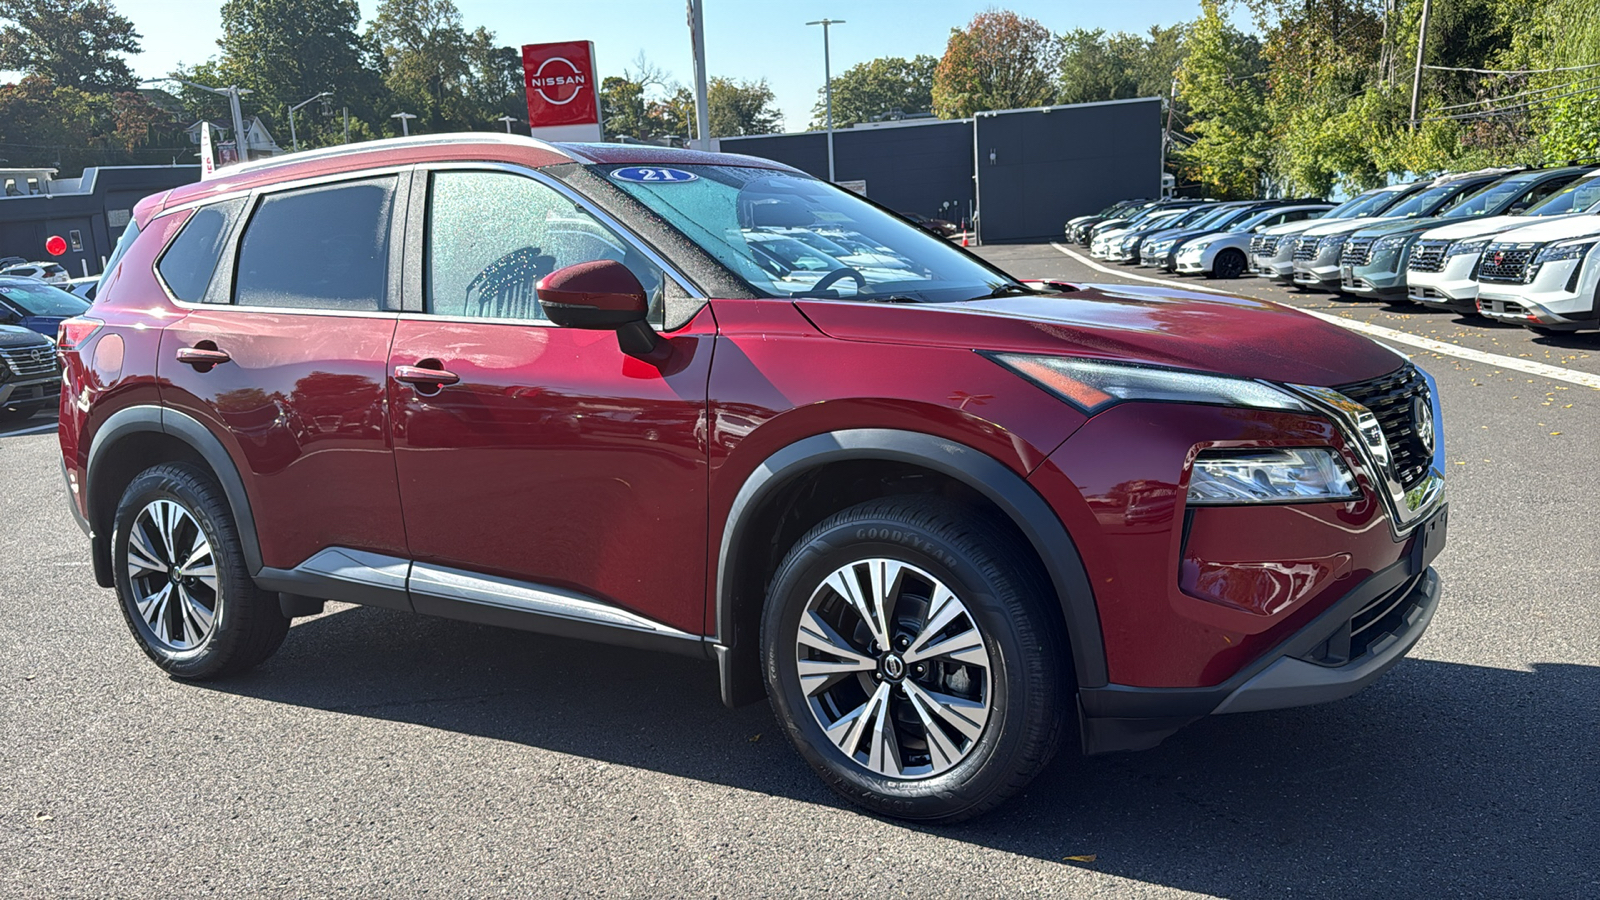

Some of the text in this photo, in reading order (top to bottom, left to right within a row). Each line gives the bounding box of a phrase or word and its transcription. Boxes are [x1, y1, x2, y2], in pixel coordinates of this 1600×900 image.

[531, 75, 585, 87] NISSAN
[638, 169, 678, 180] 21
[856, 527, 959, 569] GOODYEAR
